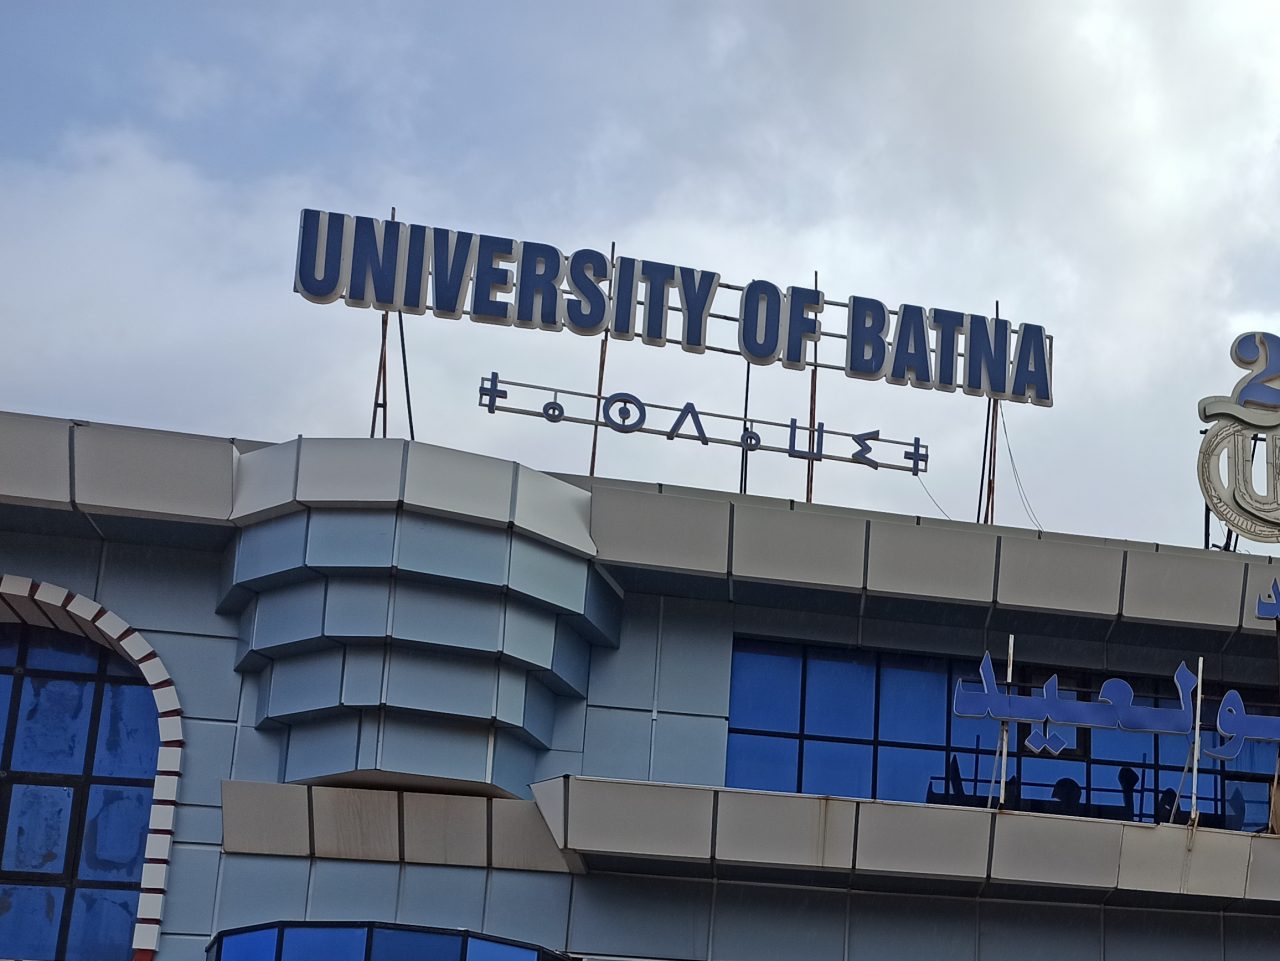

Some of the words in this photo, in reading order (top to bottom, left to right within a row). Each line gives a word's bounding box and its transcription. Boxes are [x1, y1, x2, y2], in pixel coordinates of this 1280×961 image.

[293, 207, 720, 354] UNIVERSITY
[738, 279, 822, 371] OF
[845, 294, 1055, 406] BATNA
